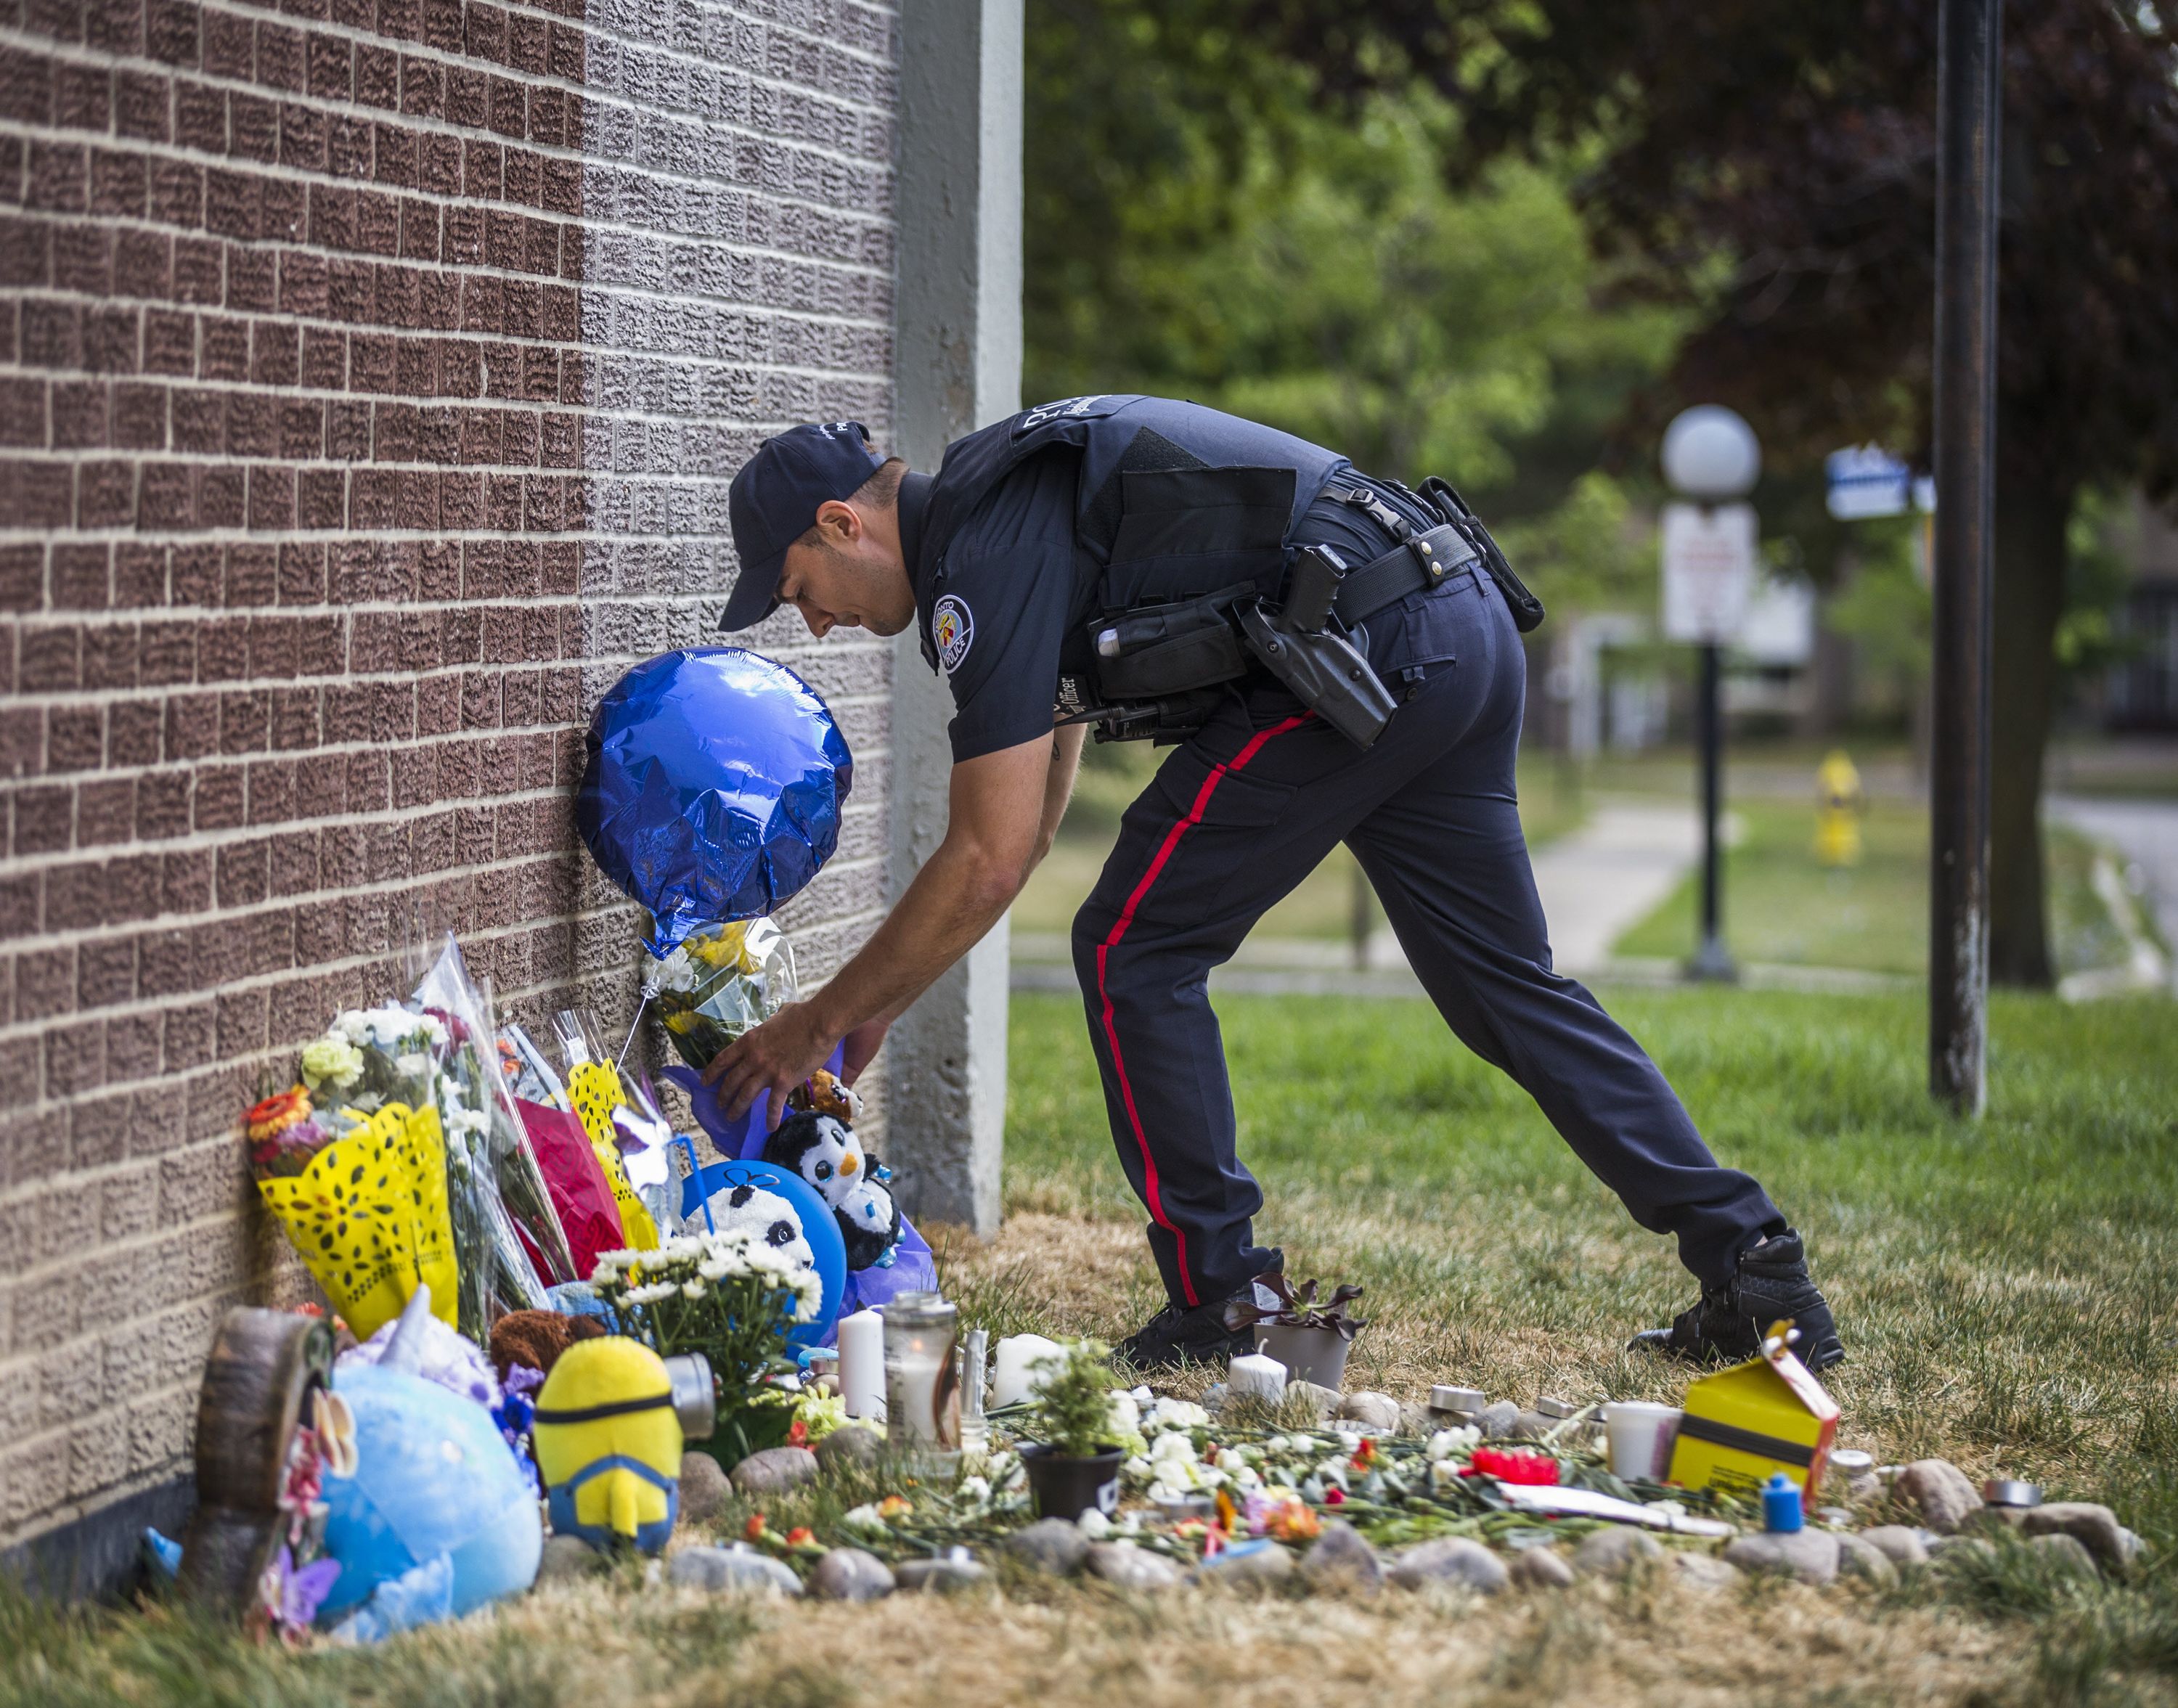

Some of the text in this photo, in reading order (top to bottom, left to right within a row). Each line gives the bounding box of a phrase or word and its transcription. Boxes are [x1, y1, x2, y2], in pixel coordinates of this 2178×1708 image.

[935, 601, 954, 634] TORONTO
[945, 637, 966, 666] POLICE
[1059, 677, 1080, 704] Officer
